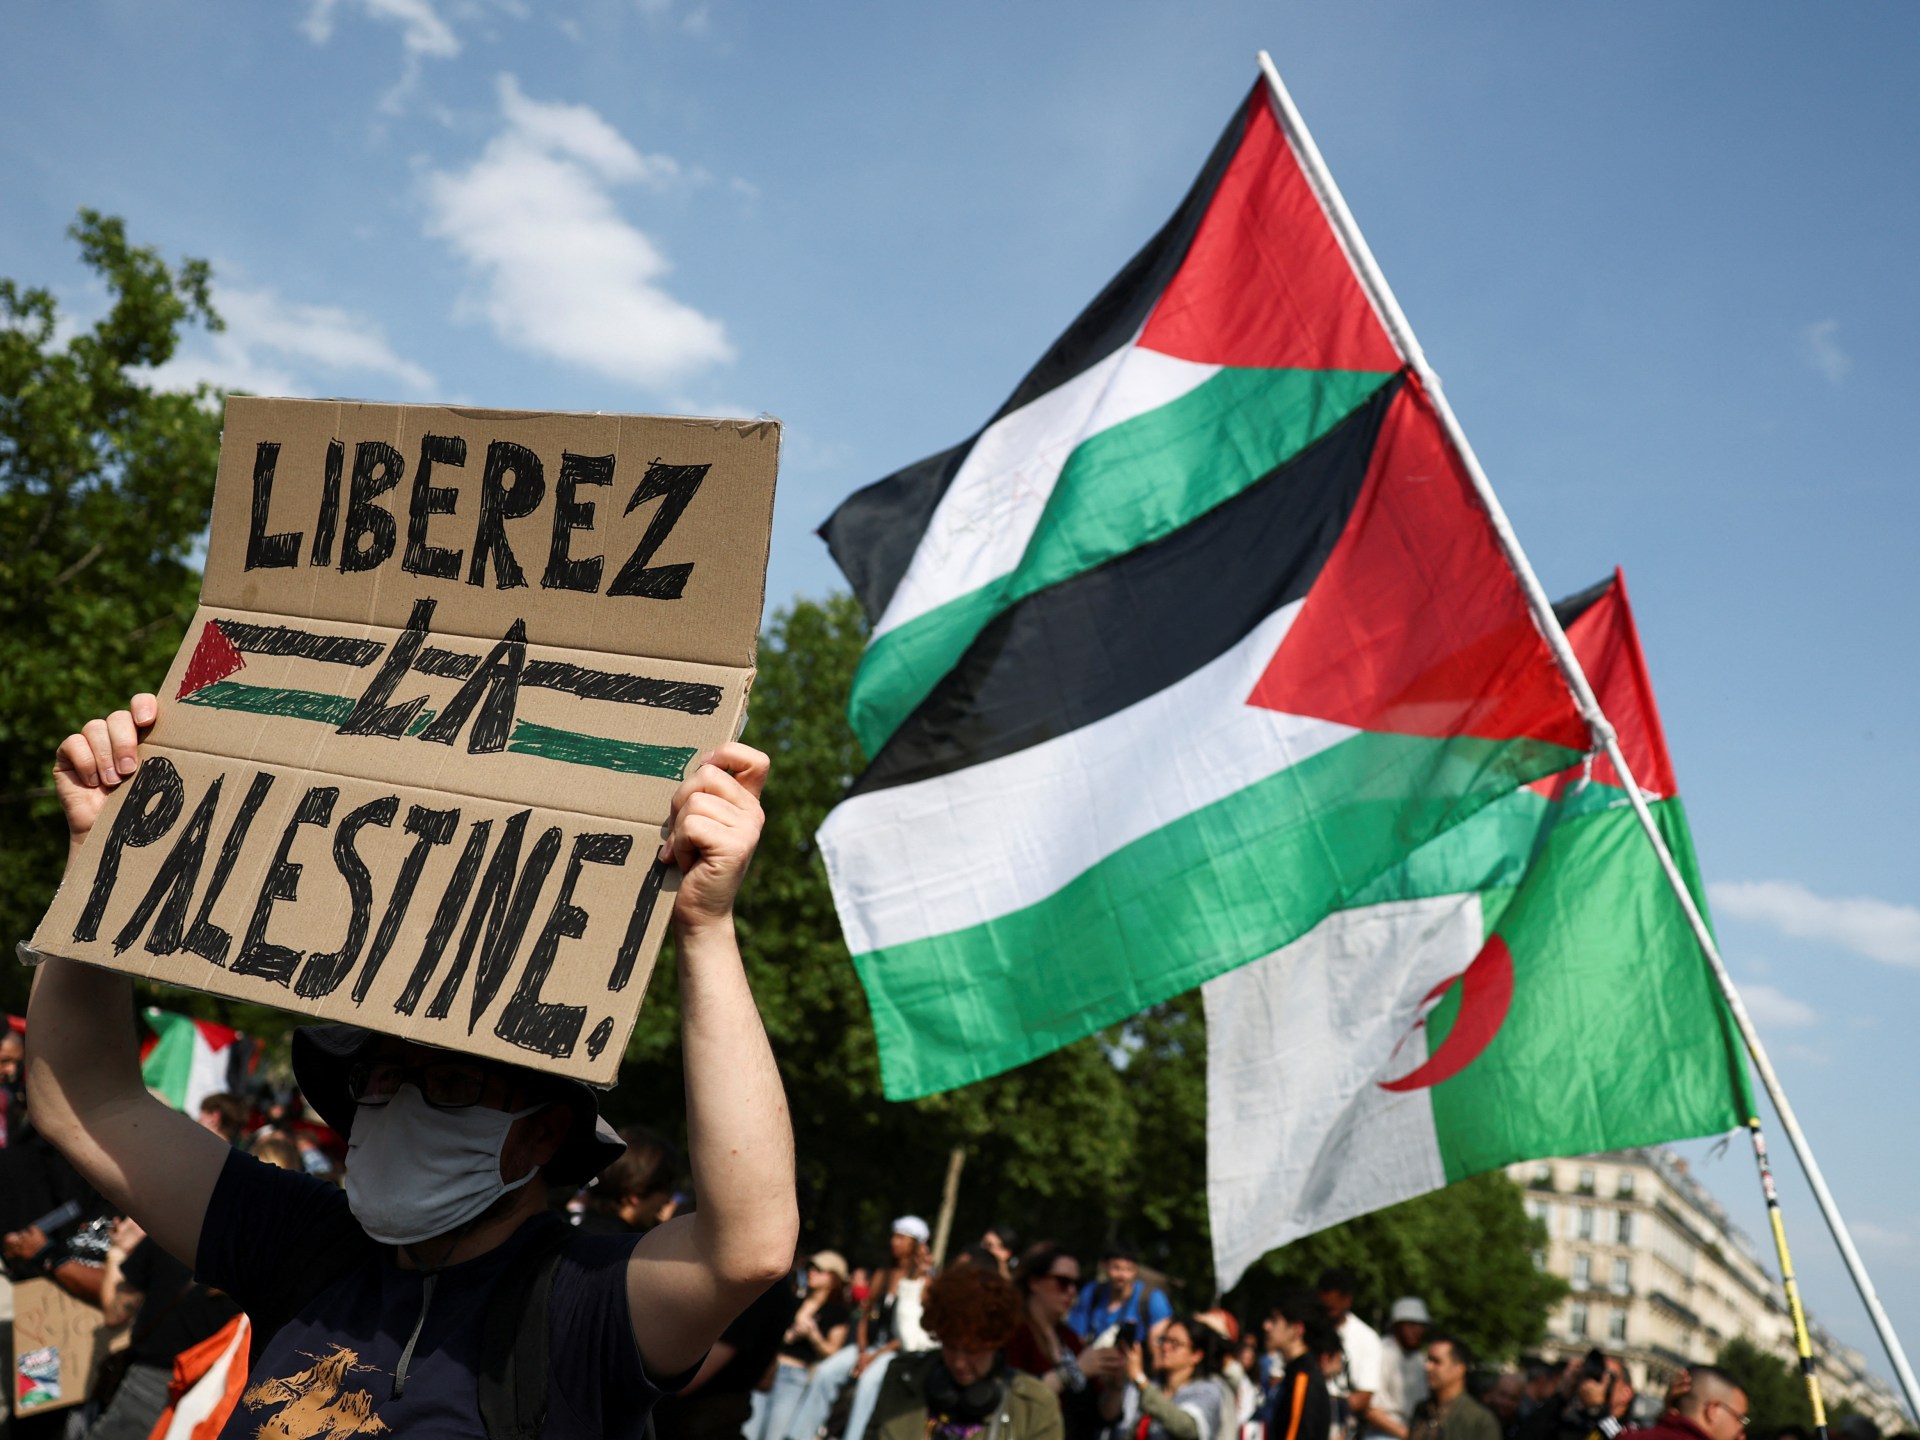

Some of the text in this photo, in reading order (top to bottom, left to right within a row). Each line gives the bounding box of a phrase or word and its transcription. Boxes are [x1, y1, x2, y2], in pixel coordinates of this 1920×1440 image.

[244, 432, 712, 600] LIBEREZ
[337, 597, 527, 754] LA
[73, 756, 668, 1060] PALESTINE!
